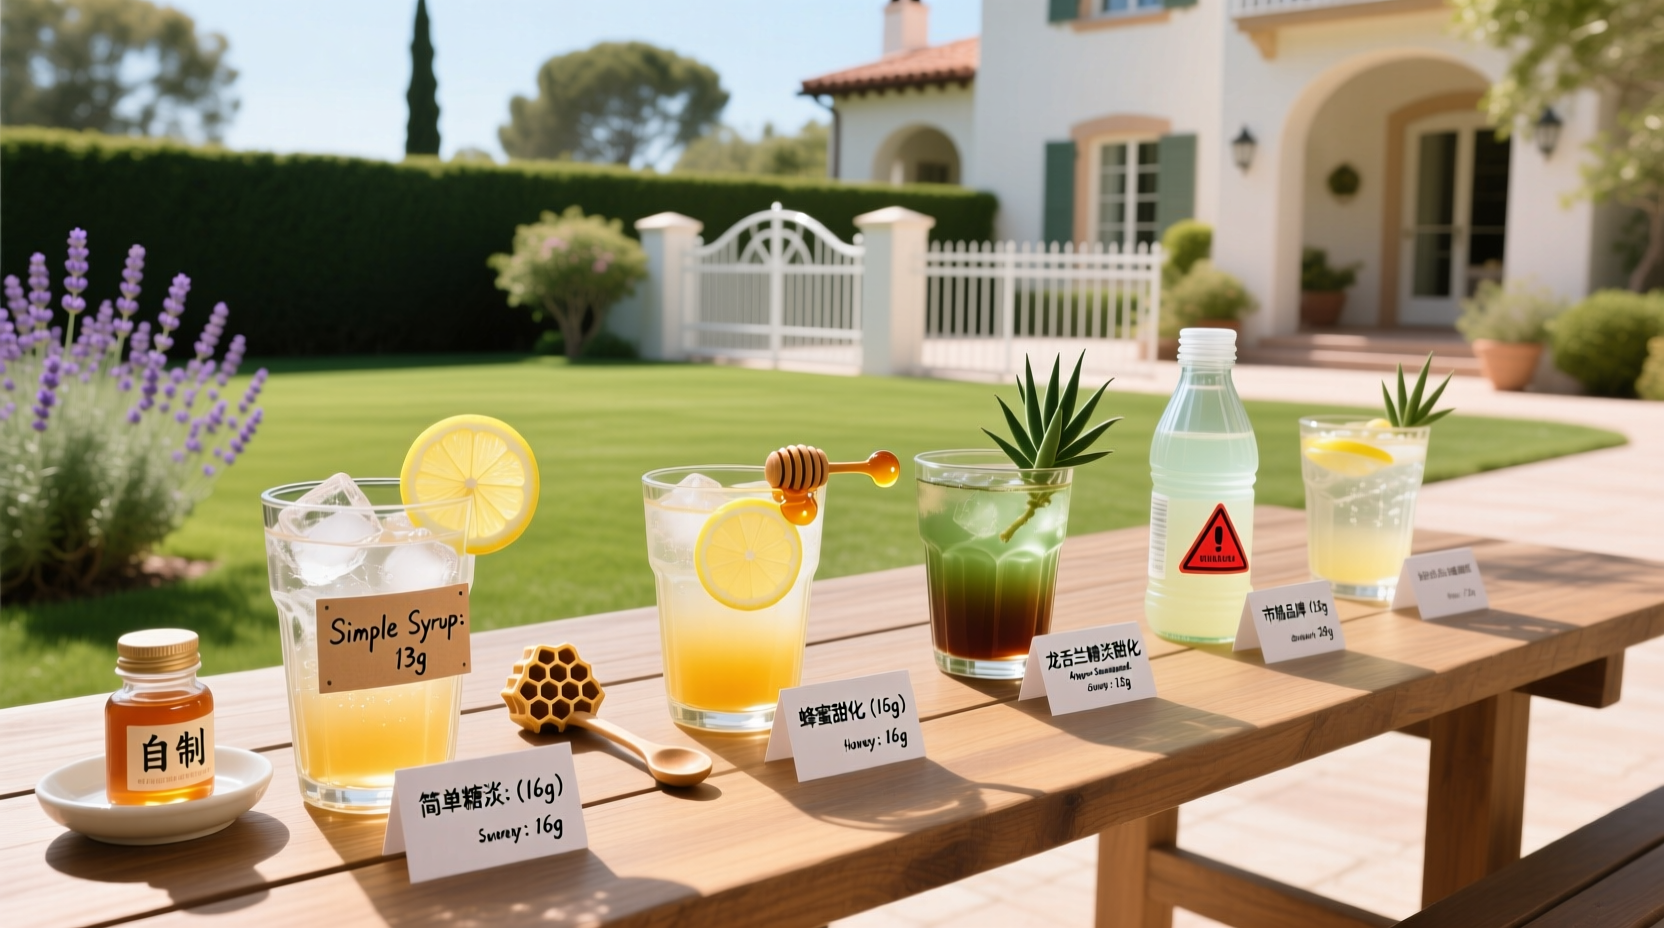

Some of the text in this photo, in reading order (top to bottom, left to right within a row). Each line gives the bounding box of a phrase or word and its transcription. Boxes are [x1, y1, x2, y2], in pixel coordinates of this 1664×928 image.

[329, 609, 465, 653] Simple Syrup:
[395, 646, 427, 676] 13g
[870, 693, 906, 719] (16g)
[142, 727, 205, 773] 自制
[885, 727, 908, 748] 16g
[516, 773, 563, 804] (16g)
[535, 814, 563, 839] 16g
